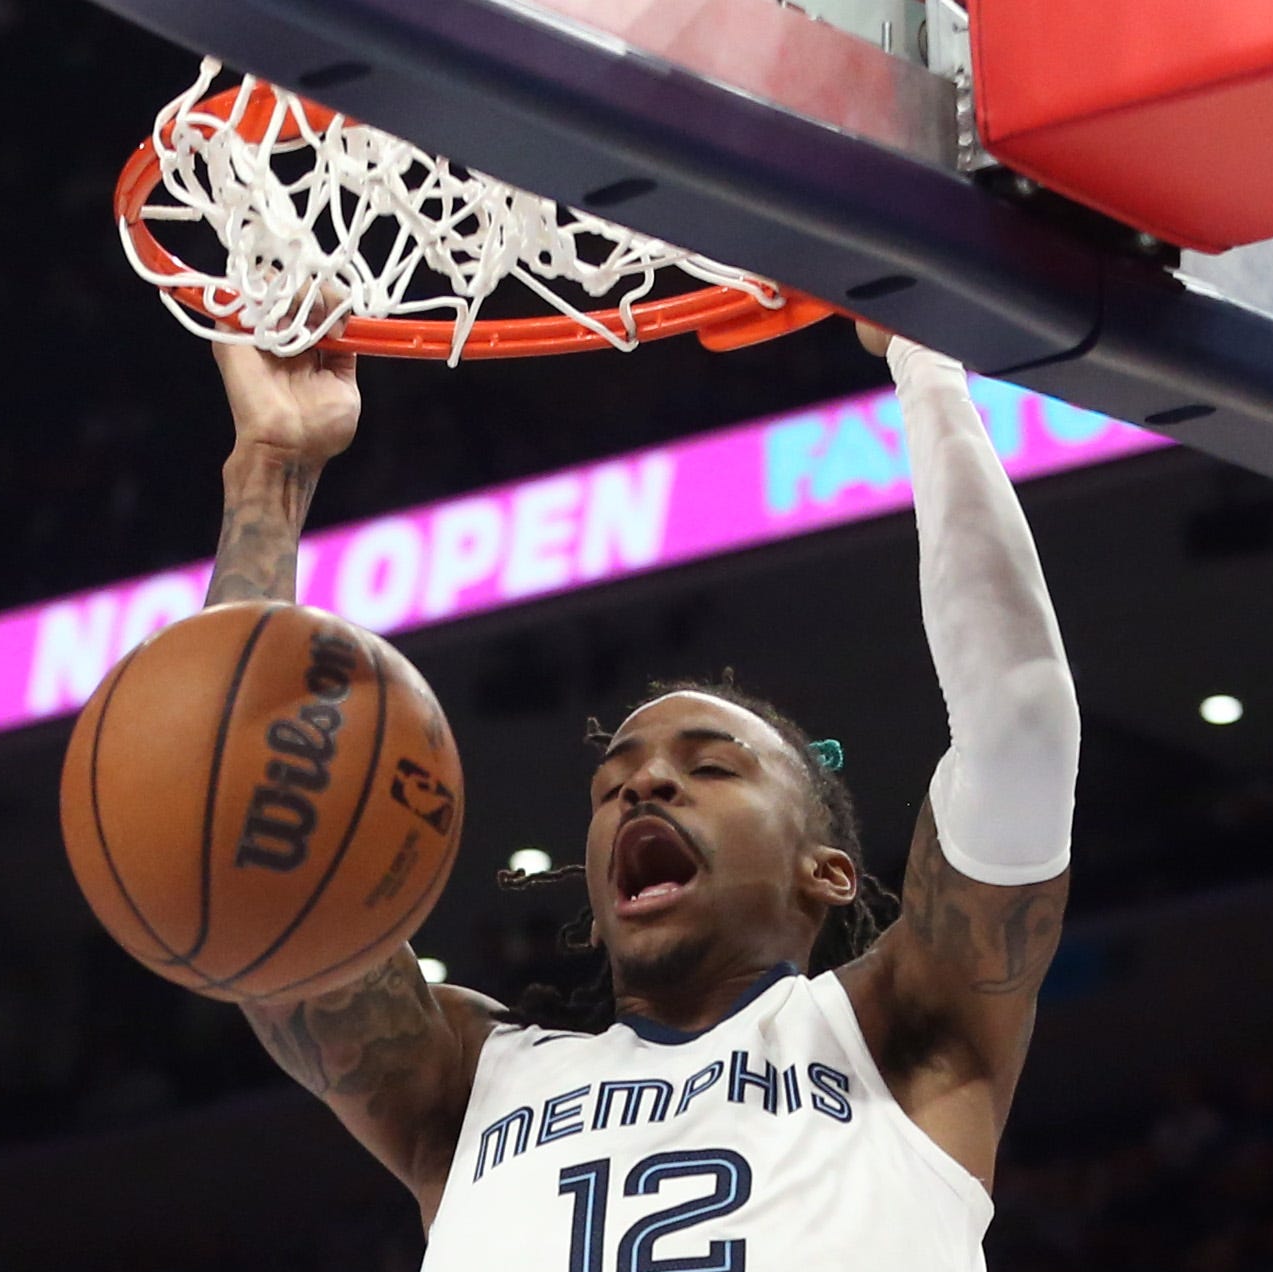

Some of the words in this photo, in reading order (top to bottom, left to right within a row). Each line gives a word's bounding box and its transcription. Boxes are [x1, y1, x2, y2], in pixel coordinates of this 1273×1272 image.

[335, 452, 677, 635] OPEN
[235, 632, 359, 872] Wilson
[473, 1050, 853, 1182] MEMPHIS
